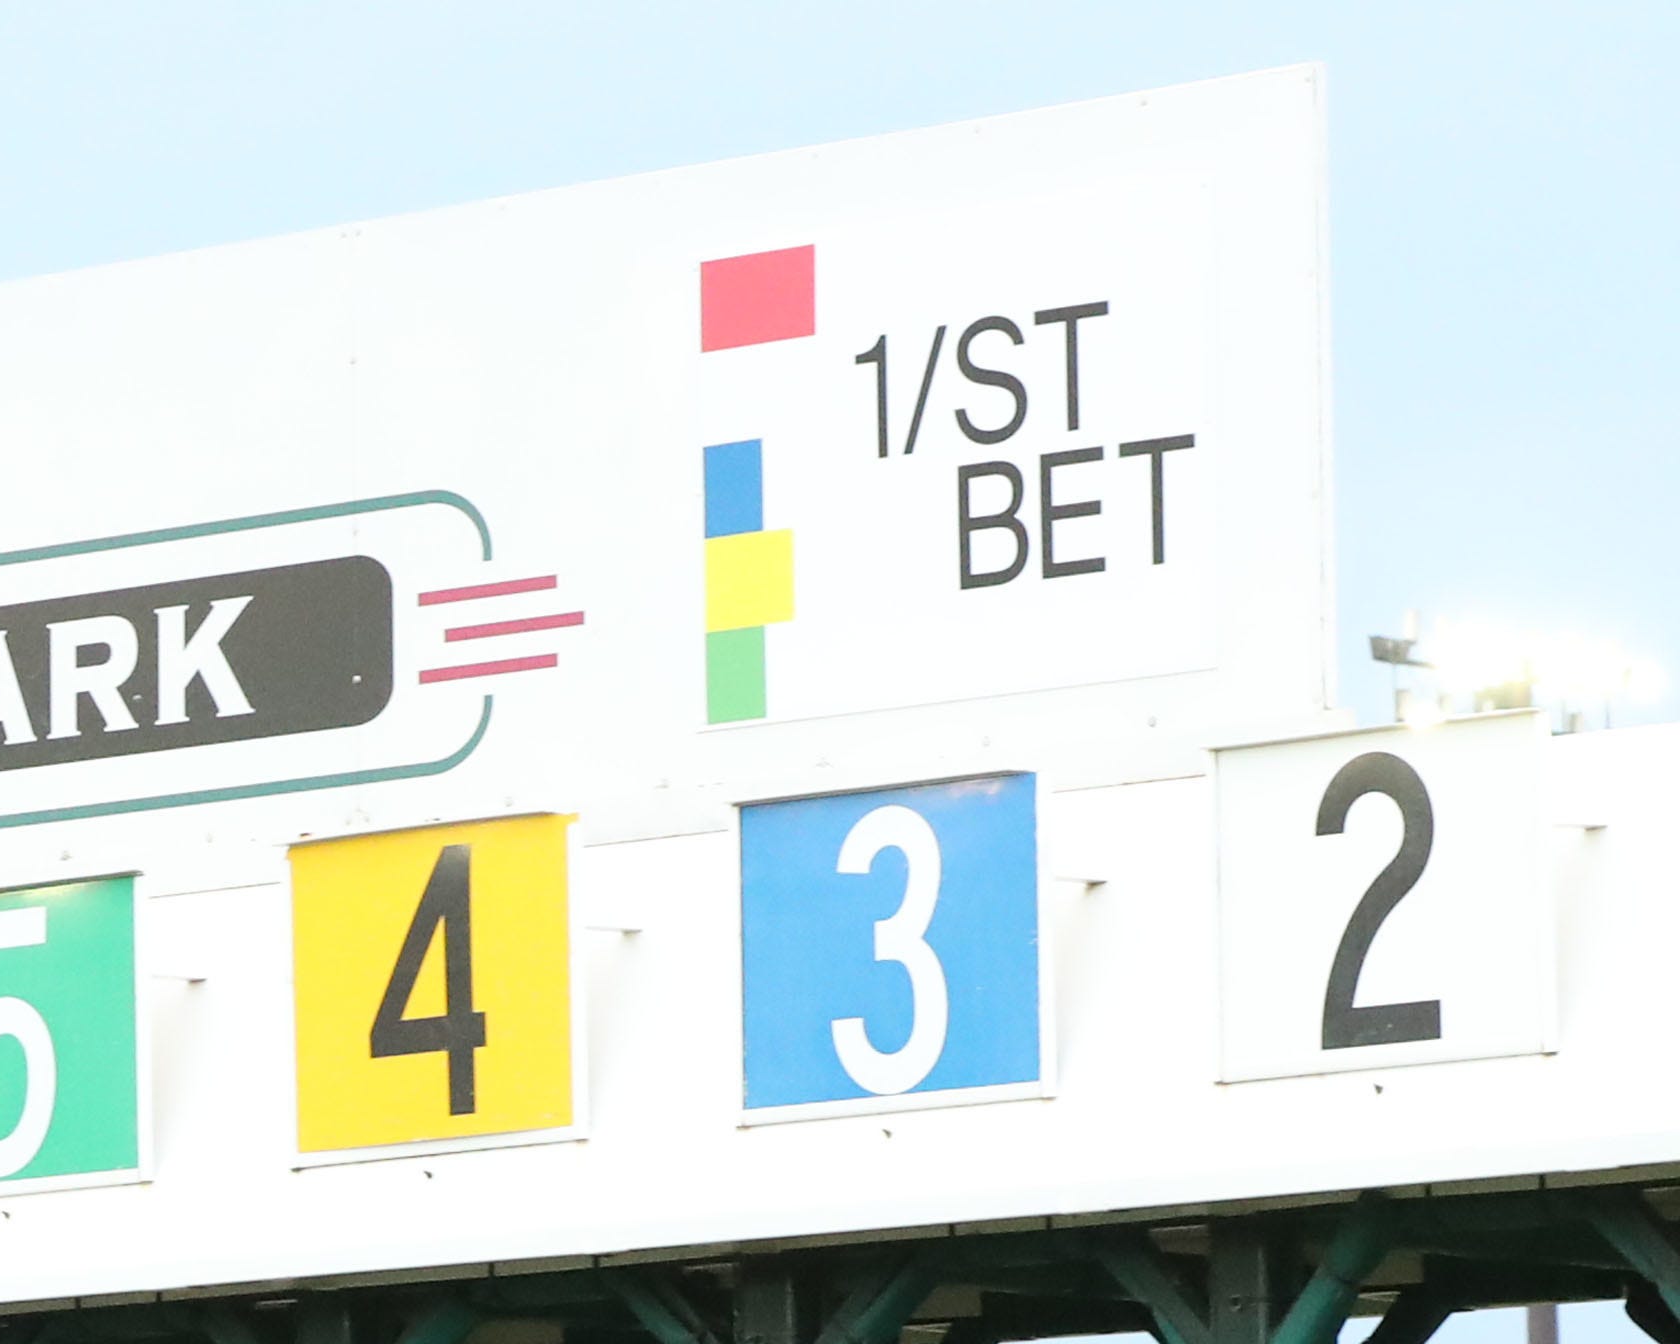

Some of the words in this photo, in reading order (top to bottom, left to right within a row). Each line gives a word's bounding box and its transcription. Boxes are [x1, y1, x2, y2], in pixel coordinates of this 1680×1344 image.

[855, 301, 1109, 460] 1/ST
[958, 433, 1195, 590] BET
[369, 842, 487, 1117] 4
[830, 803, 949, 1096] 3
[1314, 750, 1442, 1051] 2
